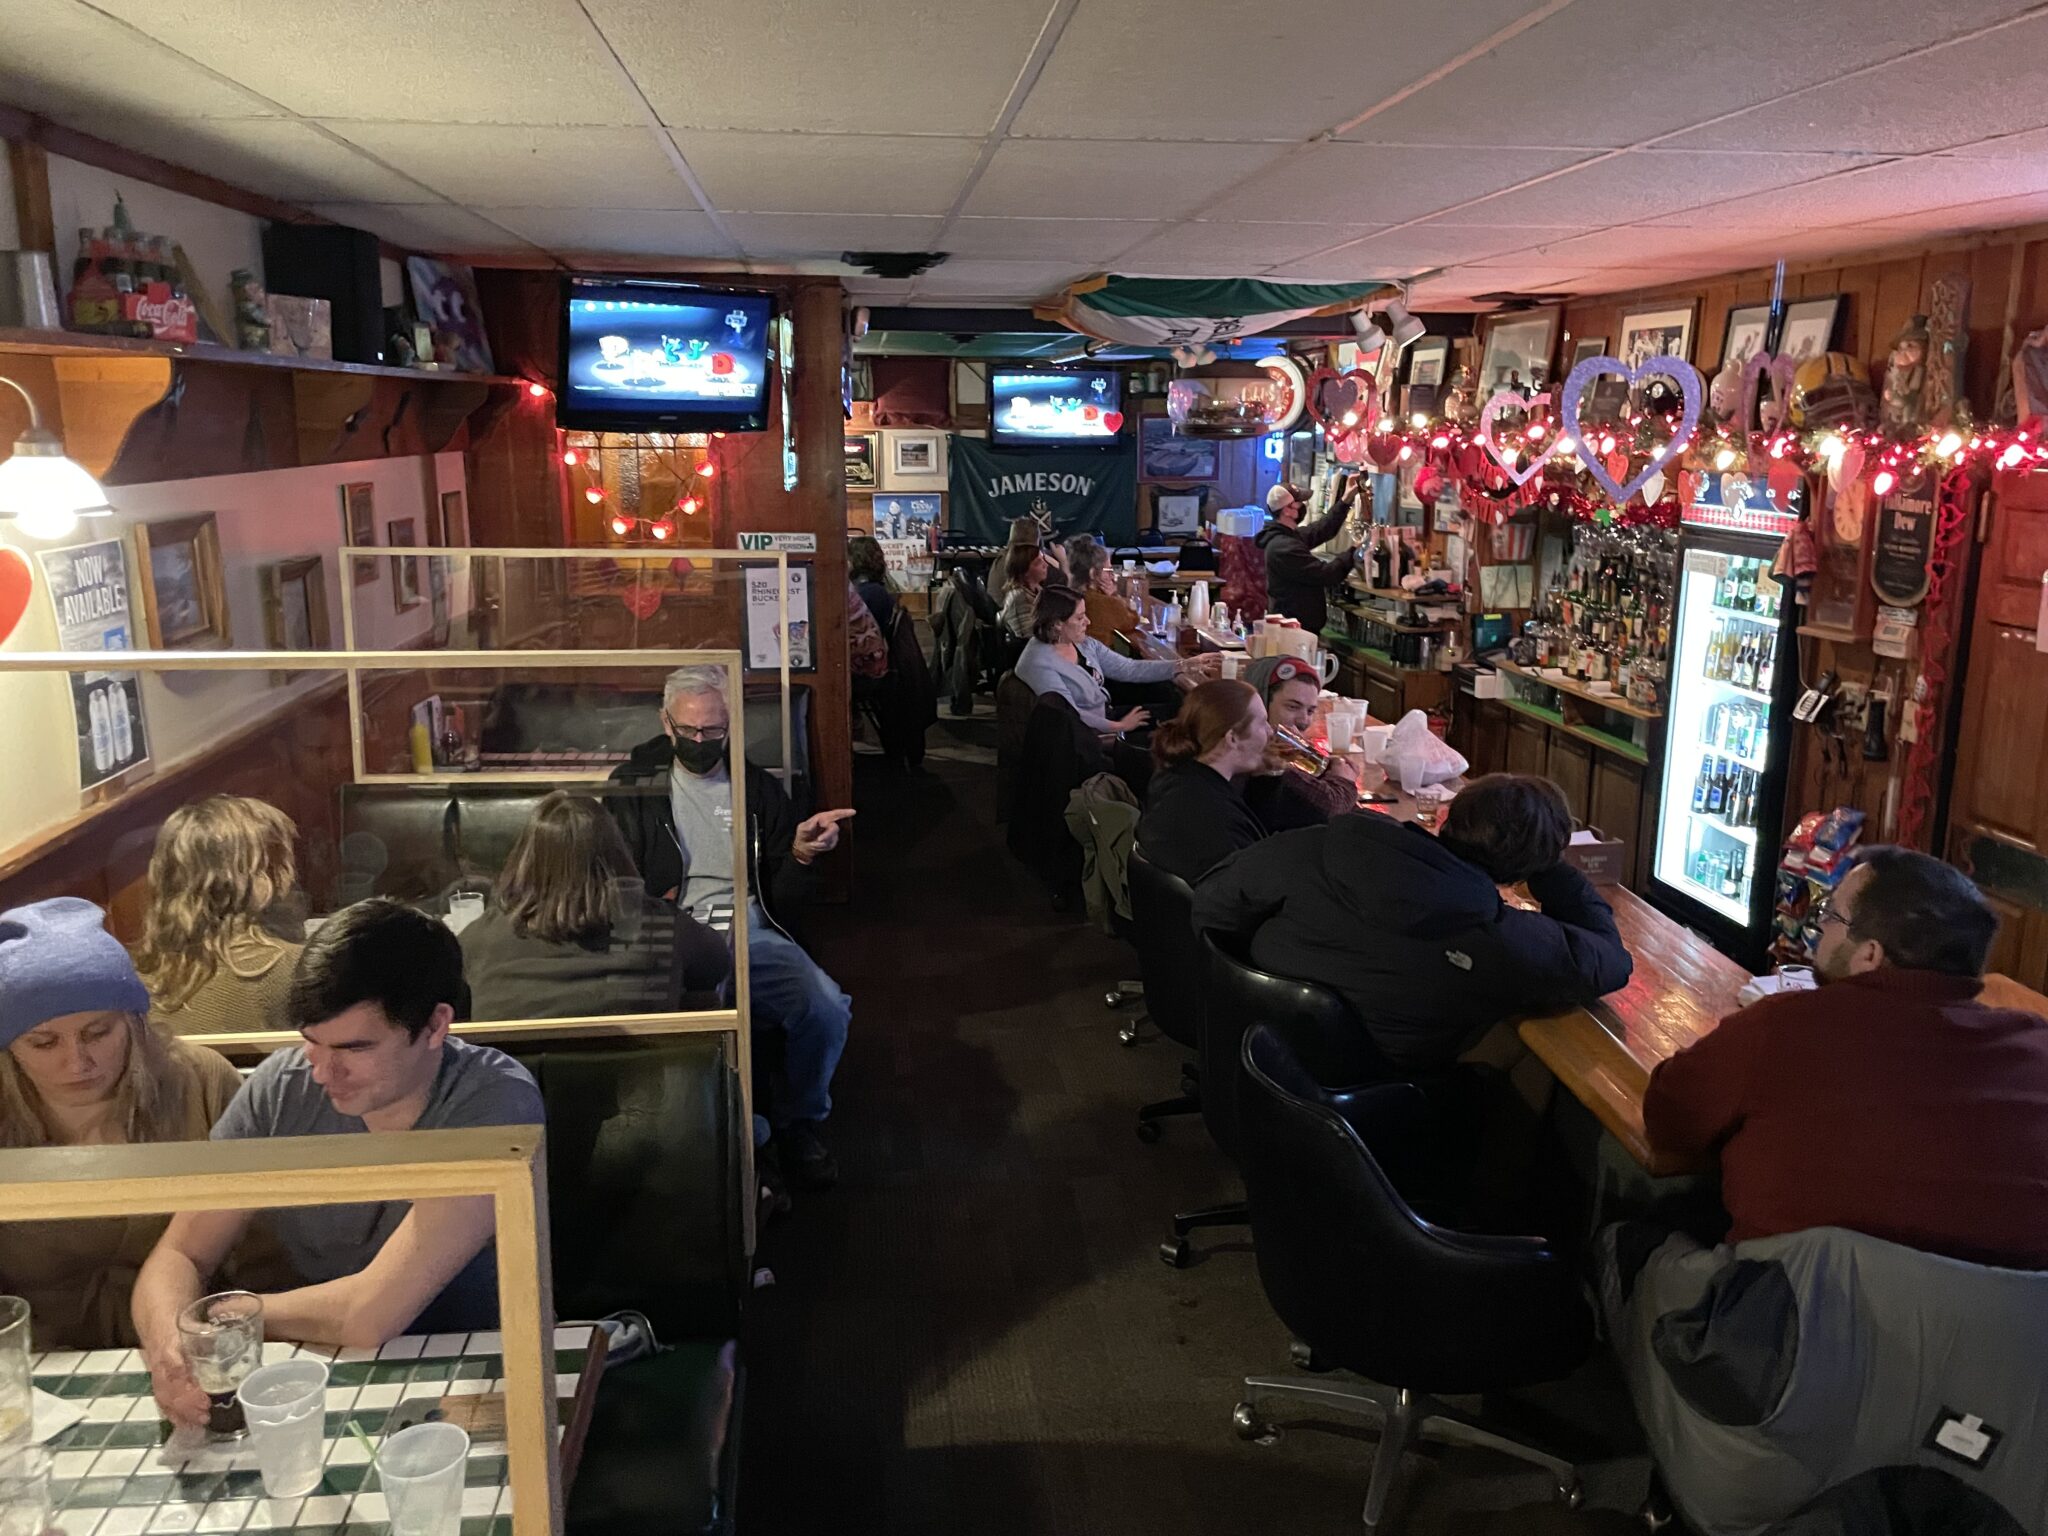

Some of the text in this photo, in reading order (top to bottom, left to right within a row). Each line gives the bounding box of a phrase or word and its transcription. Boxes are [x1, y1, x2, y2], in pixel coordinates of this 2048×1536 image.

[988, 472, 1092, 498] JAMESON
[740, 534, 773, 551] VIP
[74, 555, 103, 588] NOW
[64, 584, 122, 626] AVAILABLE
